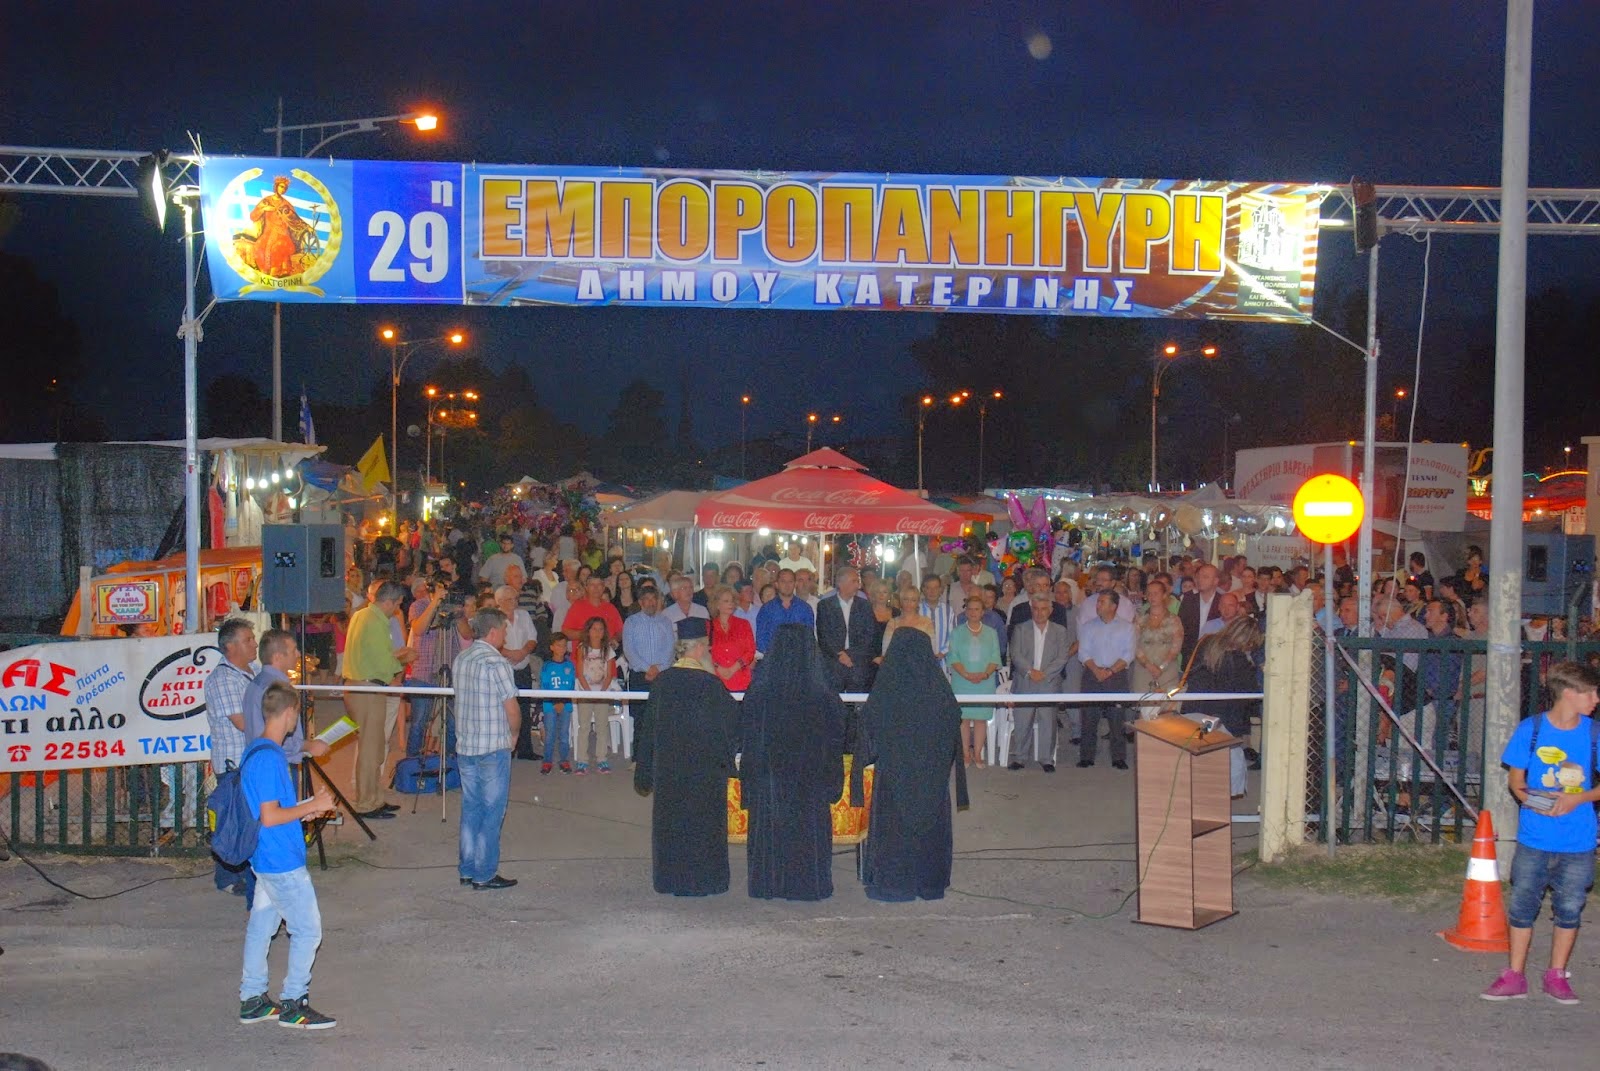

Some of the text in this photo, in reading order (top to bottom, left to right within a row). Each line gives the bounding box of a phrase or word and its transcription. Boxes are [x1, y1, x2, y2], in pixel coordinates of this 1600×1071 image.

[480, 175, 1226, 276] ΕΜΠΟΡΟΠΑΝΗΓΥΡΗ
[576, 269, 1136, 311] ΔΗΜΟΥ ΚΑΤΕΡΙΝΗΣ
[101, 584, 153, 593] ΤΑΤΣΙΟΣ
[76, 664, 110, 690] Πάντα
[147, 692, 196, 708] αλλο
[46, 706, 126, 732] αλλο
[44, 739, 126, 761] 22584
